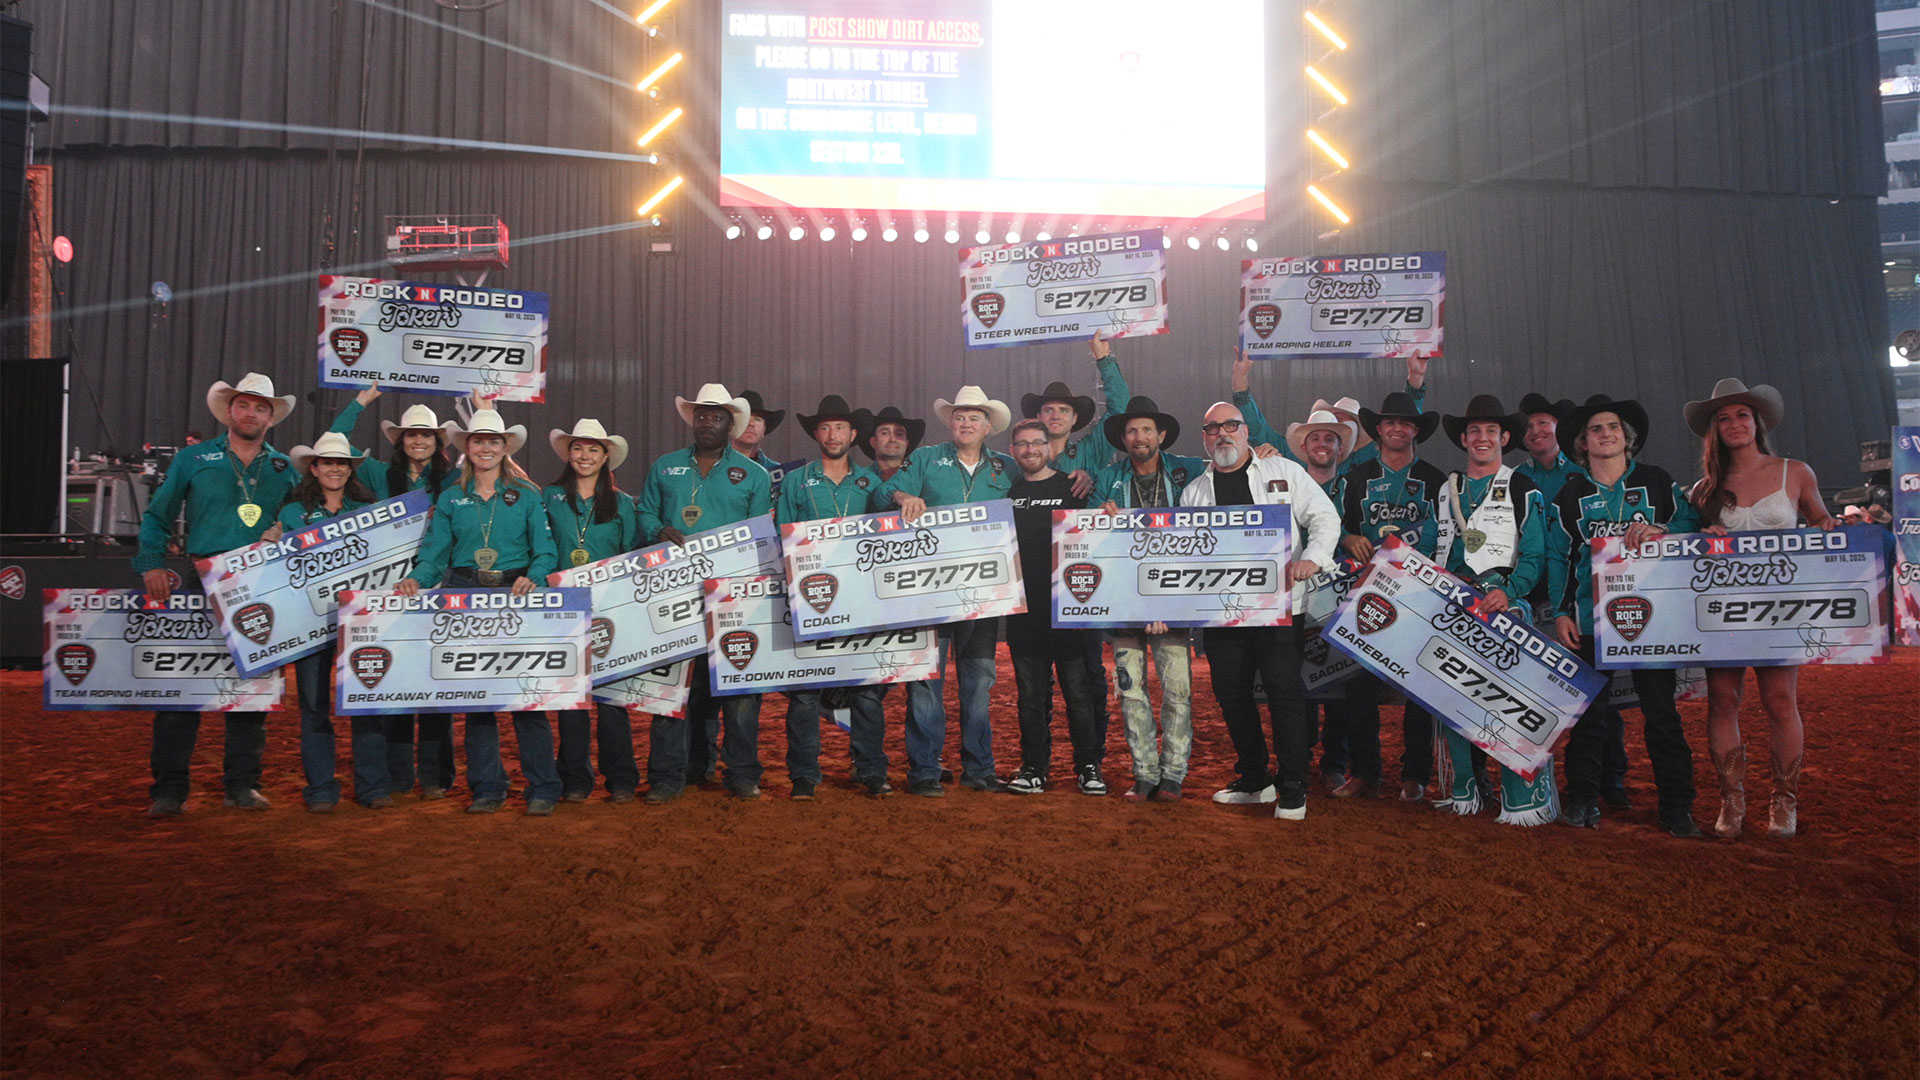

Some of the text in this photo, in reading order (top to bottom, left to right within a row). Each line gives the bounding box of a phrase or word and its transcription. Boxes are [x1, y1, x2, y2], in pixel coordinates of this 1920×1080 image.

[810, 17, 844, 37] POST
[848, 18, 888, 39] SHOW
[893, 19, 924, 40] DIRT
[928, 21, 983, 47] ACCESS,
[882, 50, 908, 71] TOP
[912, 51, 929, 72] OF
[932, 52, 958, 72] THE
[981, 236, 1141, 264] ROCK N RODEO
[1262, 256, 1422, 276] ROCK N RODEO
[344, 282, 524, 308] ROCK N RODEO
[1044, 284, 1148, 310] $27,778
[1320, 306, 1424, 327] $27,778
[974, 323, 1080, 340] STEER WRESTLING
[338, 340, 360, 349] ROCK
[412, 340, 526, 366] $27,778
[1248, 340, 1352, 350] TEAM ROPING HEELER
[331, 368, 440, 384] BARREL RACING
[1030, 498, 1062, 506] PBR
[807, 506, 988, 542] ROCK N RODEO
[1077, 510, 1263, 530] ROCK N RODEO
[224, 500, 407, 574] ROCK N RODEO
[1620, 532, 1848, 560] ROCK N RODEO
[574, 526, 752, 587] ROCK N RODEO
[1850, 554, 1866, 562] 2025
[884, 560, 998, 590] $27,778
[1071, 576, 1095, 584] ROCK
[1148, 568, 1268, 592] $27,778
[1624, 574, 1635, 582] THE
[729, 580, 786, 599] ROC
[808, 585, 832, 596] ROCK
[1607, 584, 1626, 592] ORDER
[70, 594, 140, 610] ROCK
[367, 592, 564, 612] ROCK N RODEO
[1062, 606, 1110, 616] COACH
[803, 614, 850, 628] COACH
[1362, 602, 1386, 624] ROCK
[1401, 553, 1579, 680] ROCK RODEO
[1616, 610, 1642, 620] ROCK
[1708, 599, 1856, 626] $27,778
[249, 624, 337, 664] BARREL RAC
[592, 650, 648, 673] IE-DOWN
[650, 635, 698, 656] ROPING
[728, 644, 752, 653] ROCK
[1336, 626, 1410, 679] BAREBACK
[1606, 643, 1702, 656] BAREBACK
[358, 660, 384, 669] ROCK
[441, 651, 567, 675] $27,778
[722, 667, 836, 684] TIE-DOWN ROPING
[55, 690, 181, 698] TEAM ROPING HEELER
[348, 690, 486, 702] BREAKAWAY ROPING
[1433, 646, 1546, 732] $27,778
